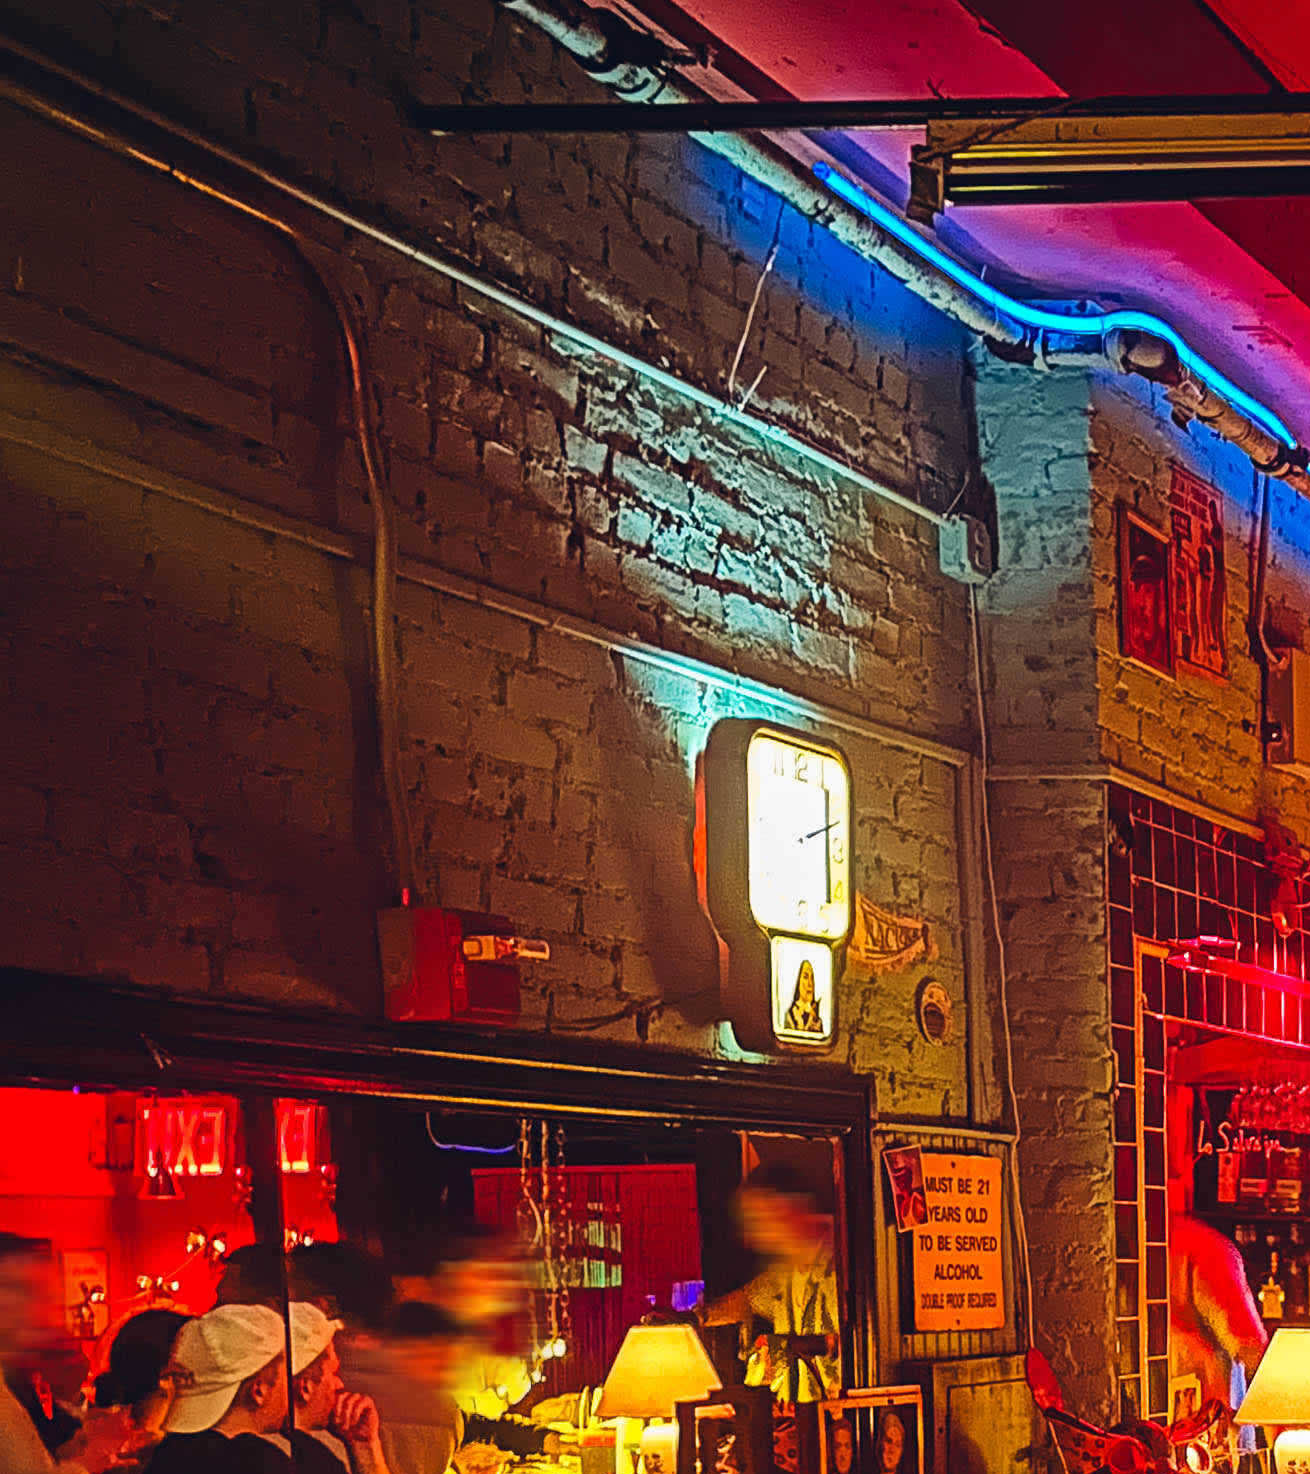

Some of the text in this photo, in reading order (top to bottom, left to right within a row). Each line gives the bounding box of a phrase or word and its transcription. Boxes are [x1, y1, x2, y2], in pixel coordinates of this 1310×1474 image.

[925, 1177, 990, 1195] MUST BE 21
[928, 1206, 988, 1224] YEARS OLD
[919, 1234, 998, 1252] TO BE SERVED
[934, 1263, 983, 1281] ALCOHOL
[920, 1292, 997, 1309] DOUBLE PROOF REQUIRED
